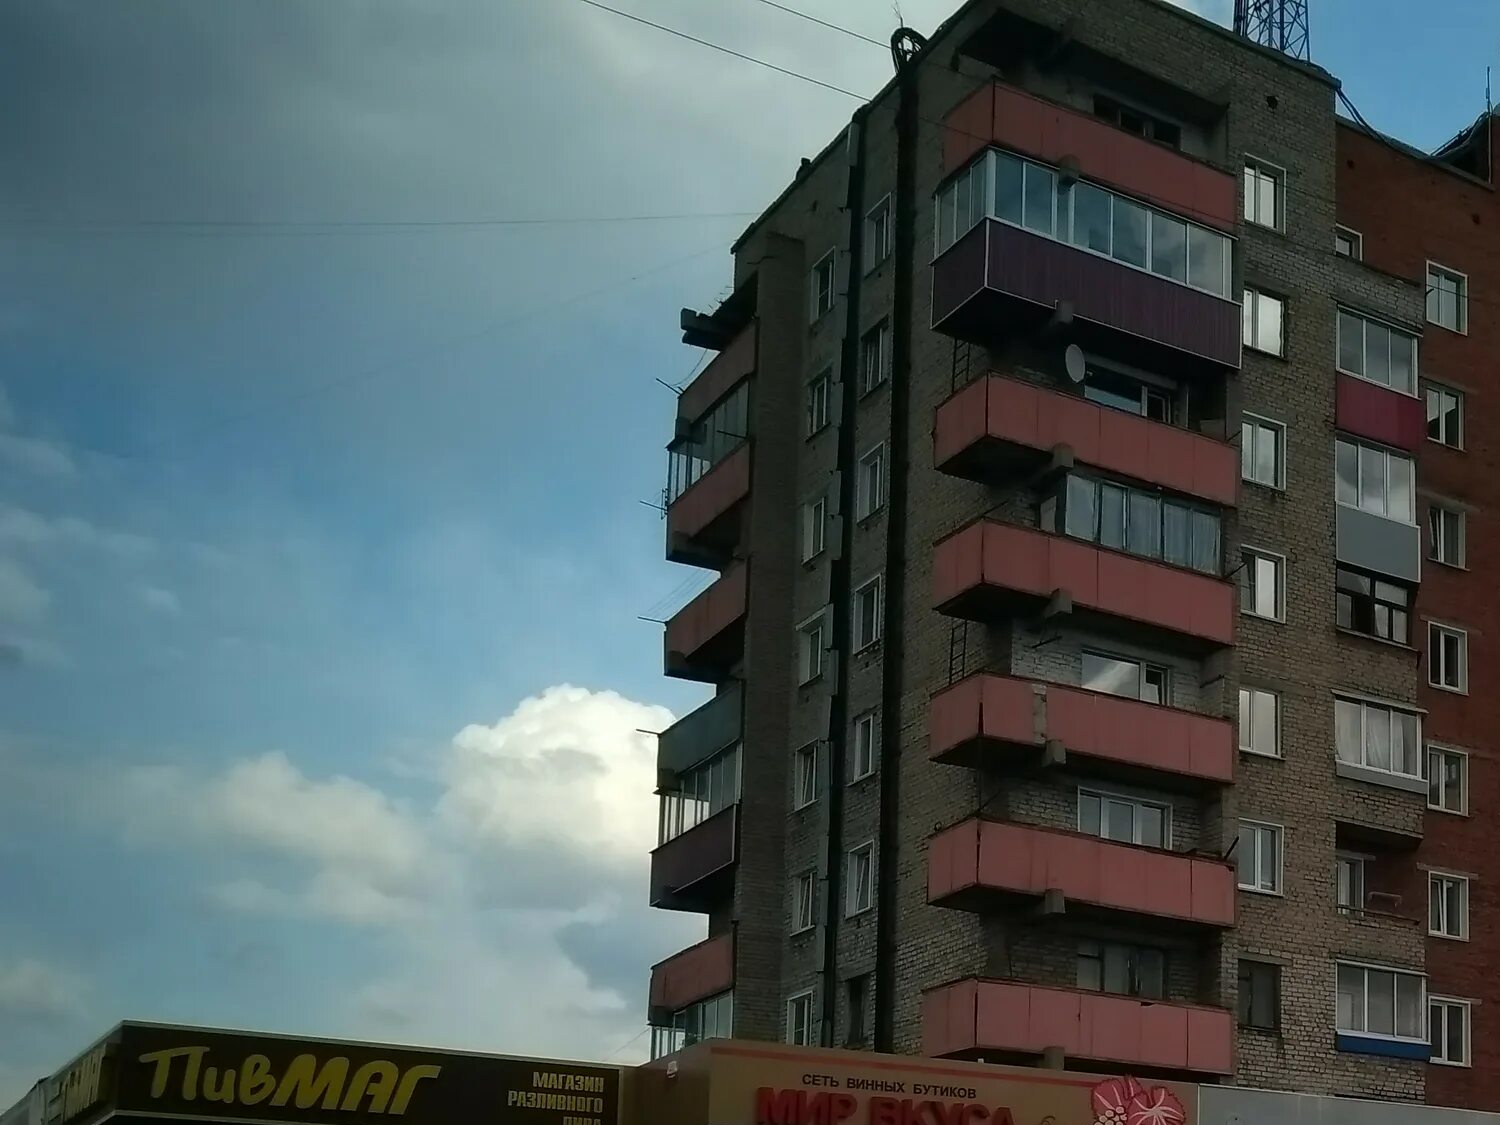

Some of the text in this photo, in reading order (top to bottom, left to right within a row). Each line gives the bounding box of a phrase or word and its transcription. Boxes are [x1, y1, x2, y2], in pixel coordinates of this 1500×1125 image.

[533, 1072, 604, 1092] МАГАЗИН
[802, 1074, 976, 1099] СЕТЬ ВИННЫХ БУТИКОВ
[507, 1090, 603, 1113] РАЗЛИВНОГО
